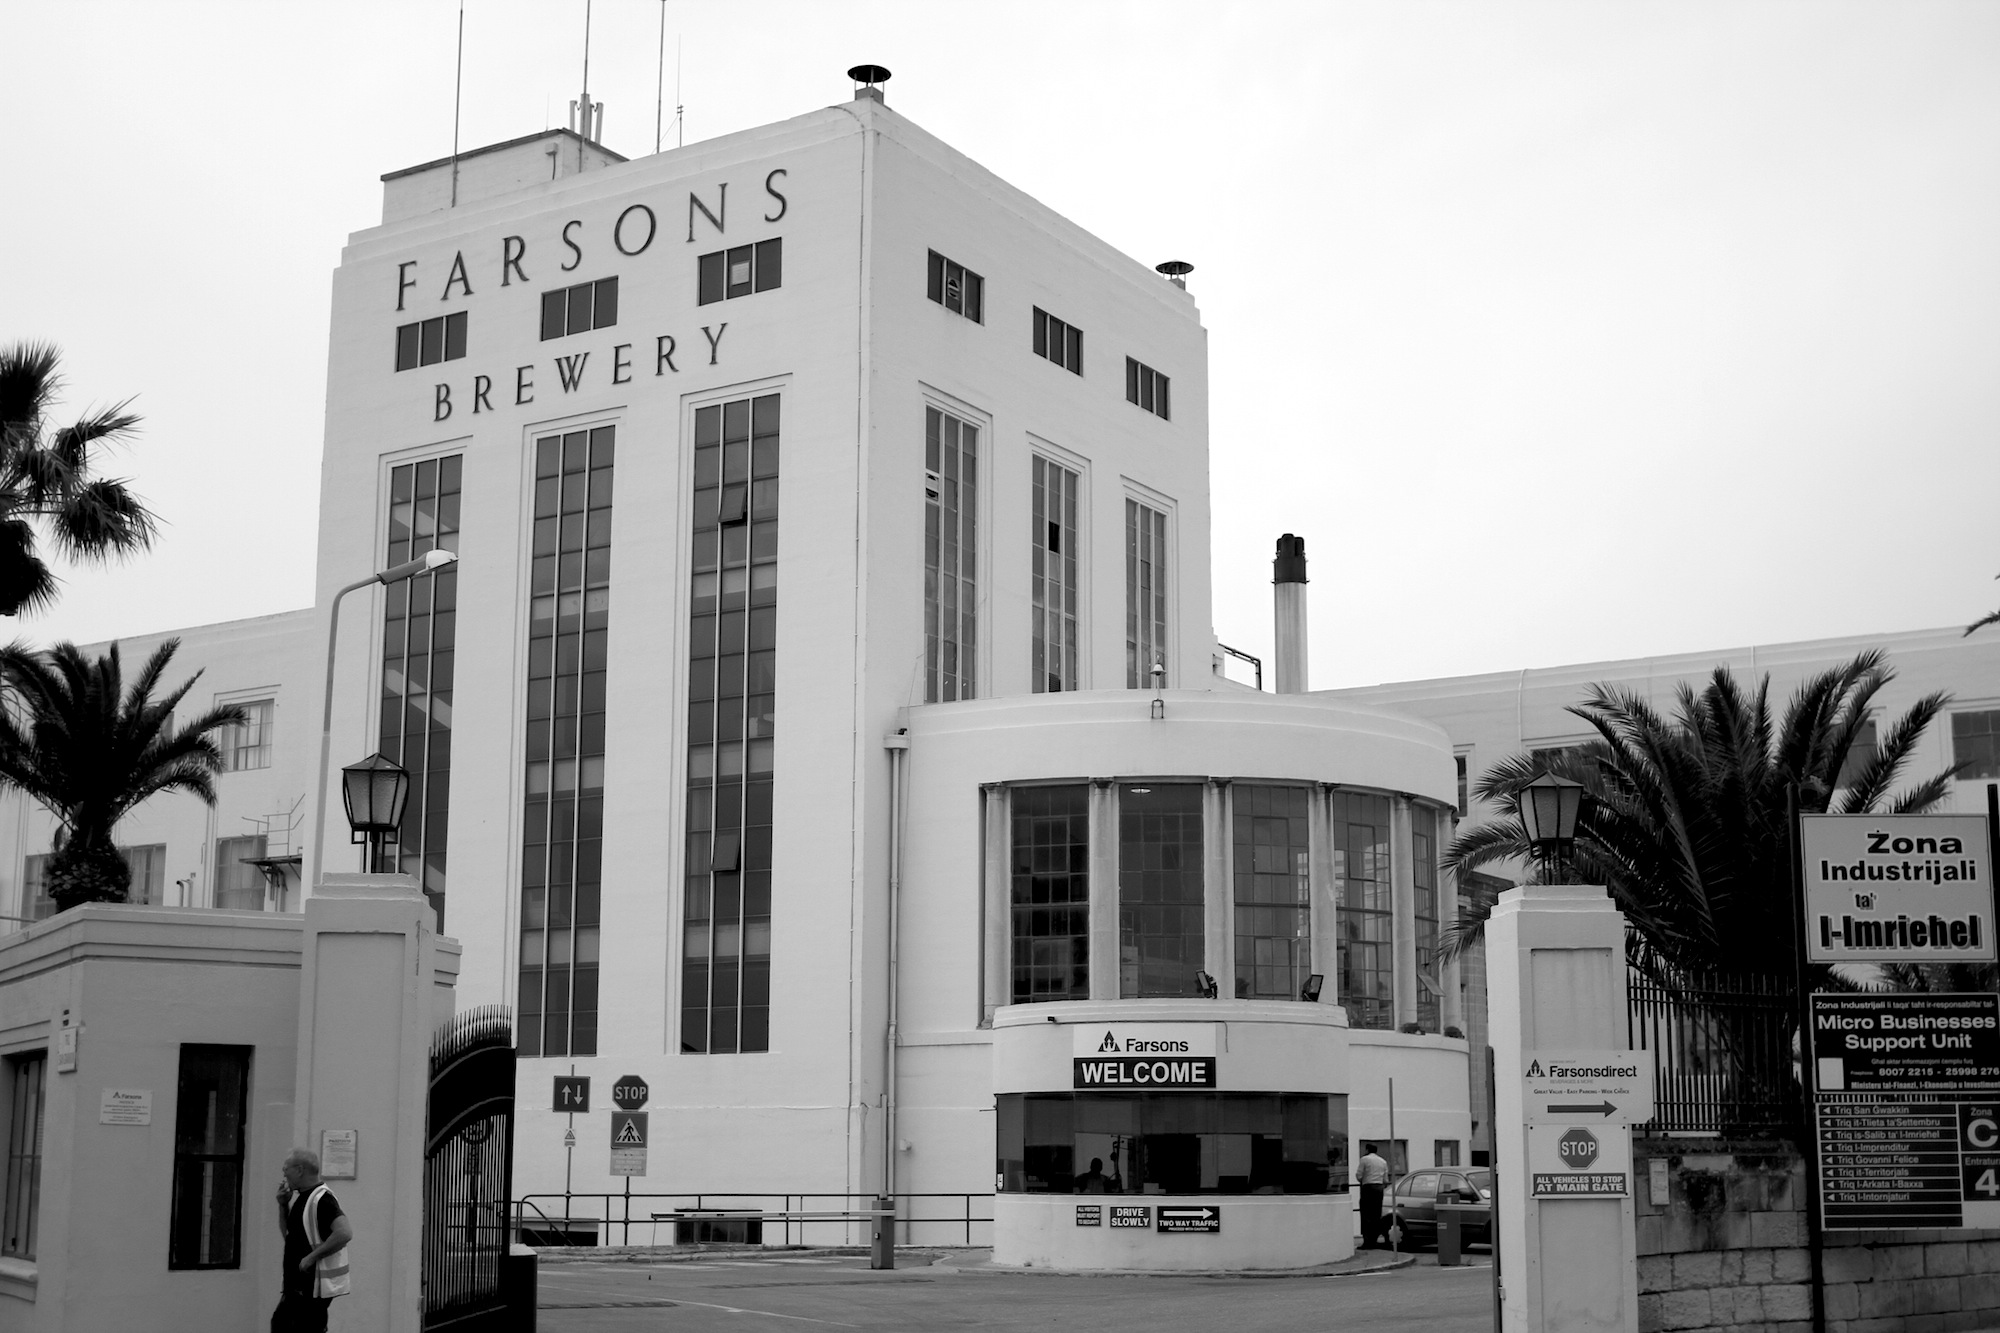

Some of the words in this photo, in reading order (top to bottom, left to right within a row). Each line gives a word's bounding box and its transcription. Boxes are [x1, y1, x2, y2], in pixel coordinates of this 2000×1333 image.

[395, 168, 788, 311] FARSONS
[433, 322, 728, 422] BREWERY
[1867, 829, 1963, 854] Żona
[1821, 860, 1976, 885] Industrijali
[1855, 892, 1876, 909] ta'
[1841, 1001, 1885, 1010] Industrijali
[1818, 1014, 1874, 1029] Micro
[1880, 1014, 1997, 1030] Businesses
[1126, 1038, 1189, 1052] Farsons
[1845, 1034, 1926, 1052] Support
[1932, 1033, 1972, 1049] Unit
[1081, 1062, 1207, 1084] WELCOME
[1550, 1065, 1637, 1077] Farsonsdirect
[1879, 1068, 1904, 1076] 8007
[1908, 1067, 1933, 1076] 2215
[1945, 1067, 1977, 1076] 25998
[615, 1086, 647, 1100] STOP
[1835, 1106, 1852, 1116] Triq
[1854, 1106, 1870, 1114] San
[1835, 1118, 1852, 1128] Triq
[1836, 1130, 1853, 1140] Triq
[1967, 1118, 1999, 1148] C
[1561, 1141, 1596, 1156] STOP
[1837, 1143, 1853, 1153] Triq
[1837, 1155, 1854, 1165] Triq
[1893, 1154, 1919, 1163] Felice
[1838, 1168, 1854, 1178] Triq
[1556, 1183, 1589, 1191] MAIN
[1592, 1183, 1624, 1191] GATE
[1838, 1180, 1855, 1190] Triq
[1975, 1168, 2000, 1197] 4
[1839, 1193, 1856, 1203] Triq
[1116, 1208, 1144, 1217] DRIVE
[1111, 1217, 1149, 1226] SLOWLY
